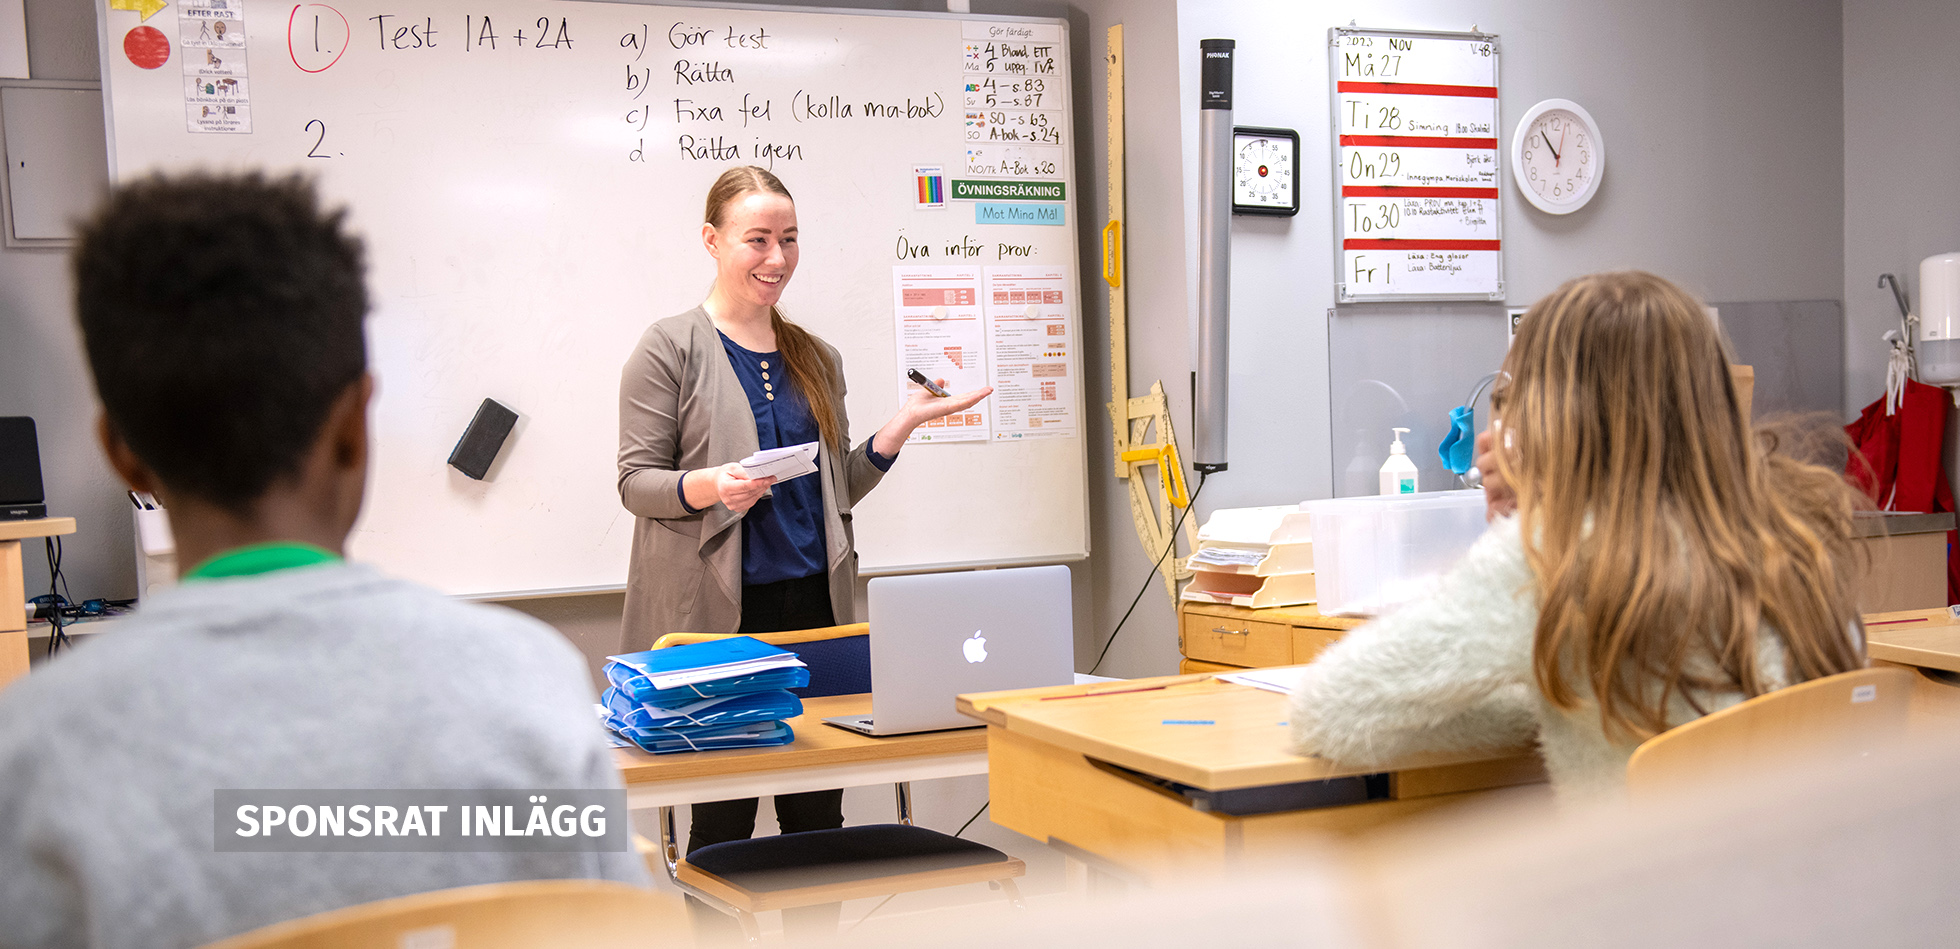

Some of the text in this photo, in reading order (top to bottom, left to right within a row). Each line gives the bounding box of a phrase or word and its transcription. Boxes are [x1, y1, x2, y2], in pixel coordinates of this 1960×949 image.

[187, 9, 234, 18] EFTER RAST
[313, 14, 332, 53] 1.
[369, 14, 438, 50] Test
[465, 14, 499, 52] 1A
[989, 26, 1034, 39] Gör färdigt:
[620, 21, 771, 62] a) Gör test
[1347, 37, 1373, 47] 2023
[1389, 38, 1412, 51] NOV
[984, 42, 997, 60] 4
[1033, 46, 1052, 58] ETT
[965, 62, 980, 71] Ma
[986, 58, 997, 72] 5
[1034, 58, 1054, 74] TVÅ
[1345, 53, 1401, 77] Må 27
[626, 59, 734, 100] b) Rätta
[965, 84, 981, 92] ABC
[966, 97, 976, 106] Sv
[985, 94, 997, 108] 5
[626, 89, 944, 131] c) Fixa fel (kolla ma-bok)
[1346, 101, 1401, 130] Ti 28
[989, 112, 1006, 126] SO
[1550, 117, 1560, 131] 12
[989, 127, 1021, 141] A-bok
[1408, 119, 1448, 136] Simning
[304, 119, 344, 158] 2.
[967, 131, 981, 140] SO
[1529, 134, 1539, 149] 10
[1576, 134, 1583, 148] 2
[629, 134, 803, 171] d Rätta igen
[1525, 151, 1532, 164] 9
[1580, 150, 1588, 164] 3
[1350, 151, 1400, 179] On 29
[1530, 167, 1537, 180] 8
[1576, 168, 1582, 180] 4
[957, 182, 1061, 197] ÖVNINGSRÄKNING
[1540, 180, 1546, 192] 7
[1554, 183, 1561, 196] 6
[1566, 179, 1574, 192] 5
[983, 207, 1058, 220] Mot Mina Mål
[1348, 203, 1400, 232] To 30
[896, 228, 1038, 261] Öva inför prov:
[1355, 255, 1377, 283] Fr
